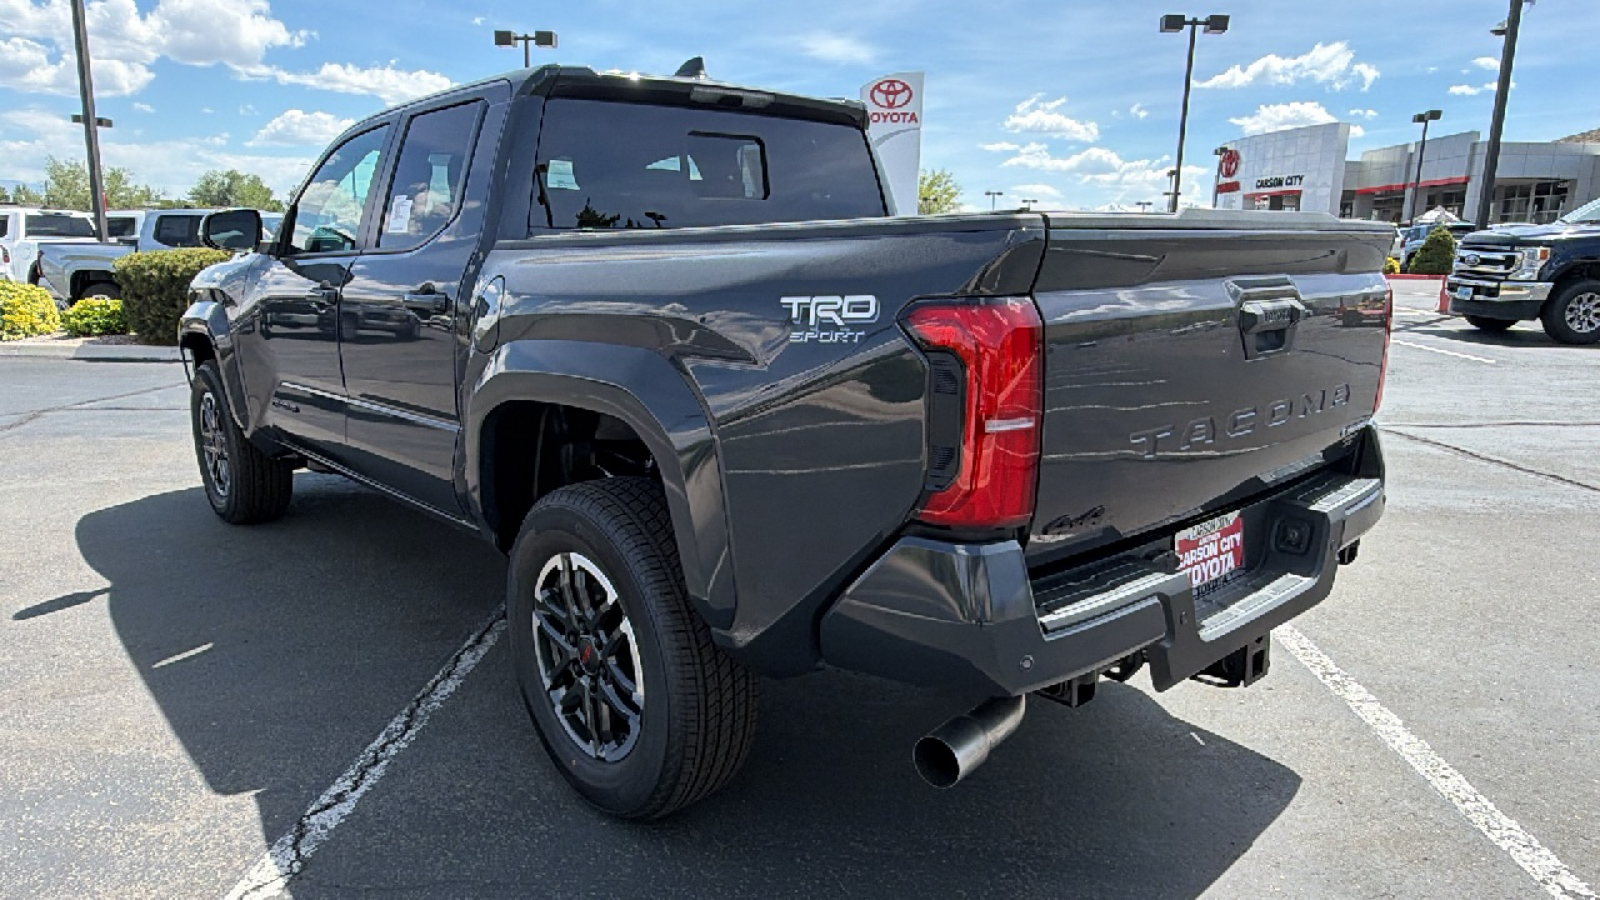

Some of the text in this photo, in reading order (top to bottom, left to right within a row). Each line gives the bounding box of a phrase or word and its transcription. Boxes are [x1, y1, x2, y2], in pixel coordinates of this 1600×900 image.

[869, 112, 918, 123] OYOTA
[1256, 174, 1305, 189] CARSON CITY
[780, 295, 880, 327] TRD
[789, 330, 866, 343] SPORT
[1129, 383, 1350, 459] TACOMA
[1179, 532, 1241, 569] CARSON CITY
